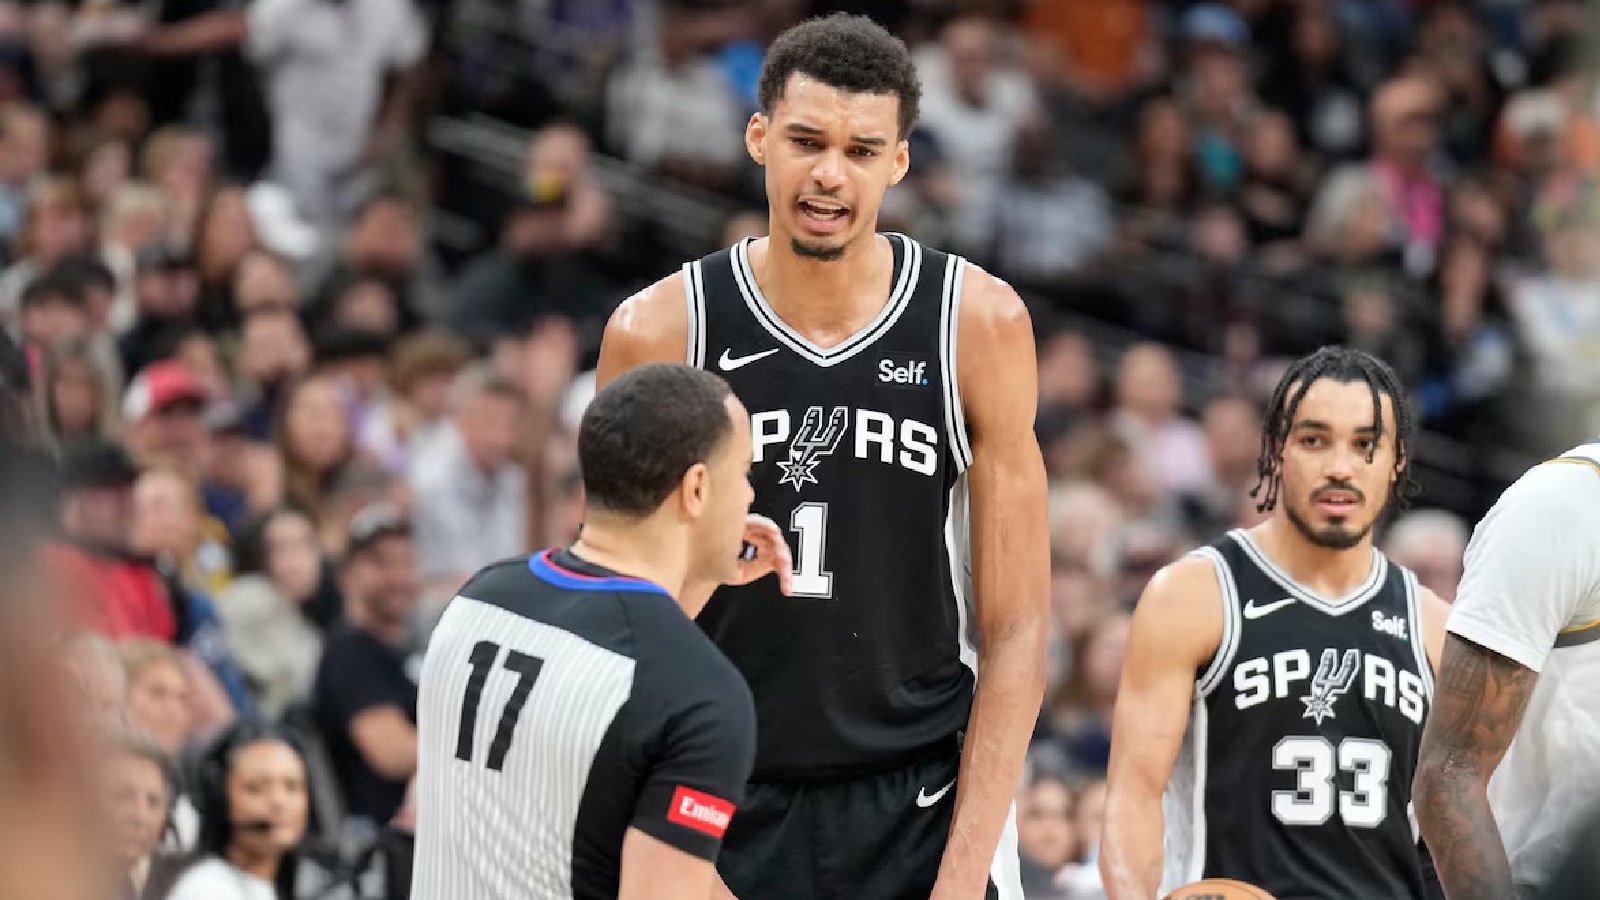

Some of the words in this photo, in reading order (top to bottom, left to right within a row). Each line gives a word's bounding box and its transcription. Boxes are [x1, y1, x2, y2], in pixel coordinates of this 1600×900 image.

[878, 358, 928, 385] Self.
[752, 406, 938, 492] PURS
[789, 502, 833, 599] 1
[455, 640, 545, 772] 17
[1234, 648, 1425, 725] SPURS
[1271, 735, 1393, 829] 33
